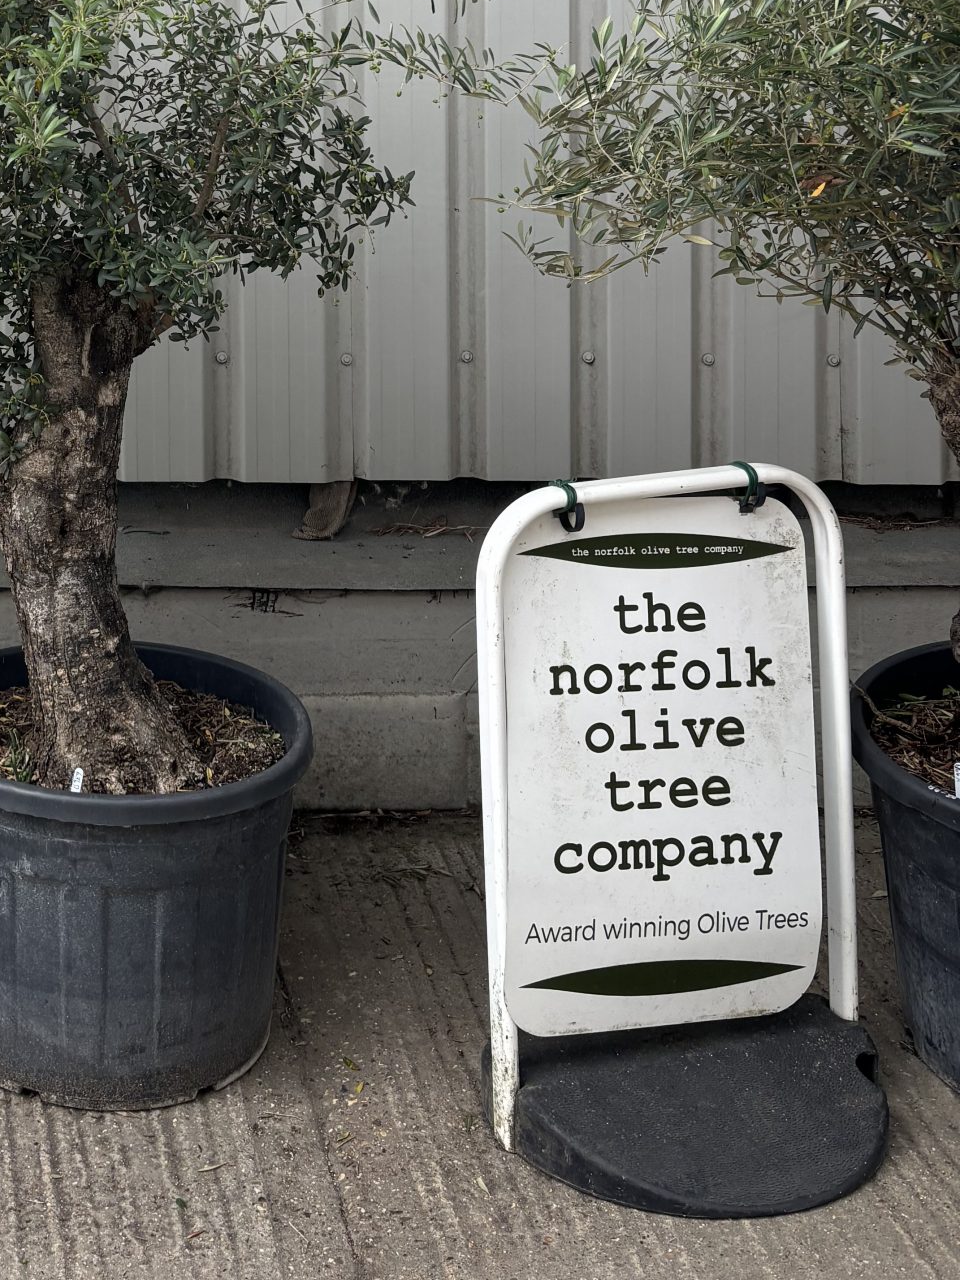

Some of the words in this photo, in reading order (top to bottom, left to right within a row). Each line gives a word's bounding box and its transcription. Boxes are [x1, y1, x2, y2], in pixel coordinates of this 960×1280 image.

[571, 547, 590, 557] the
[594, 546, 636, 556] norfolk
[641, 545, 671, 555] olive
[675, 545, 699, 554] tree
[704, 544, 744, 555] company
[613, 592, 706, 634] the
[549, 646, 775, 695] norfolk
[585, 707, 745, 753] olive
[604, 771, 731, 811] tree
[553, 831, 782, 881] company
[524, 918, 596, 945] Award
[602, 916, 691, 941] winning
[697, 910, 750, 934] Olive
[755, 909, 809, 931] Trees
